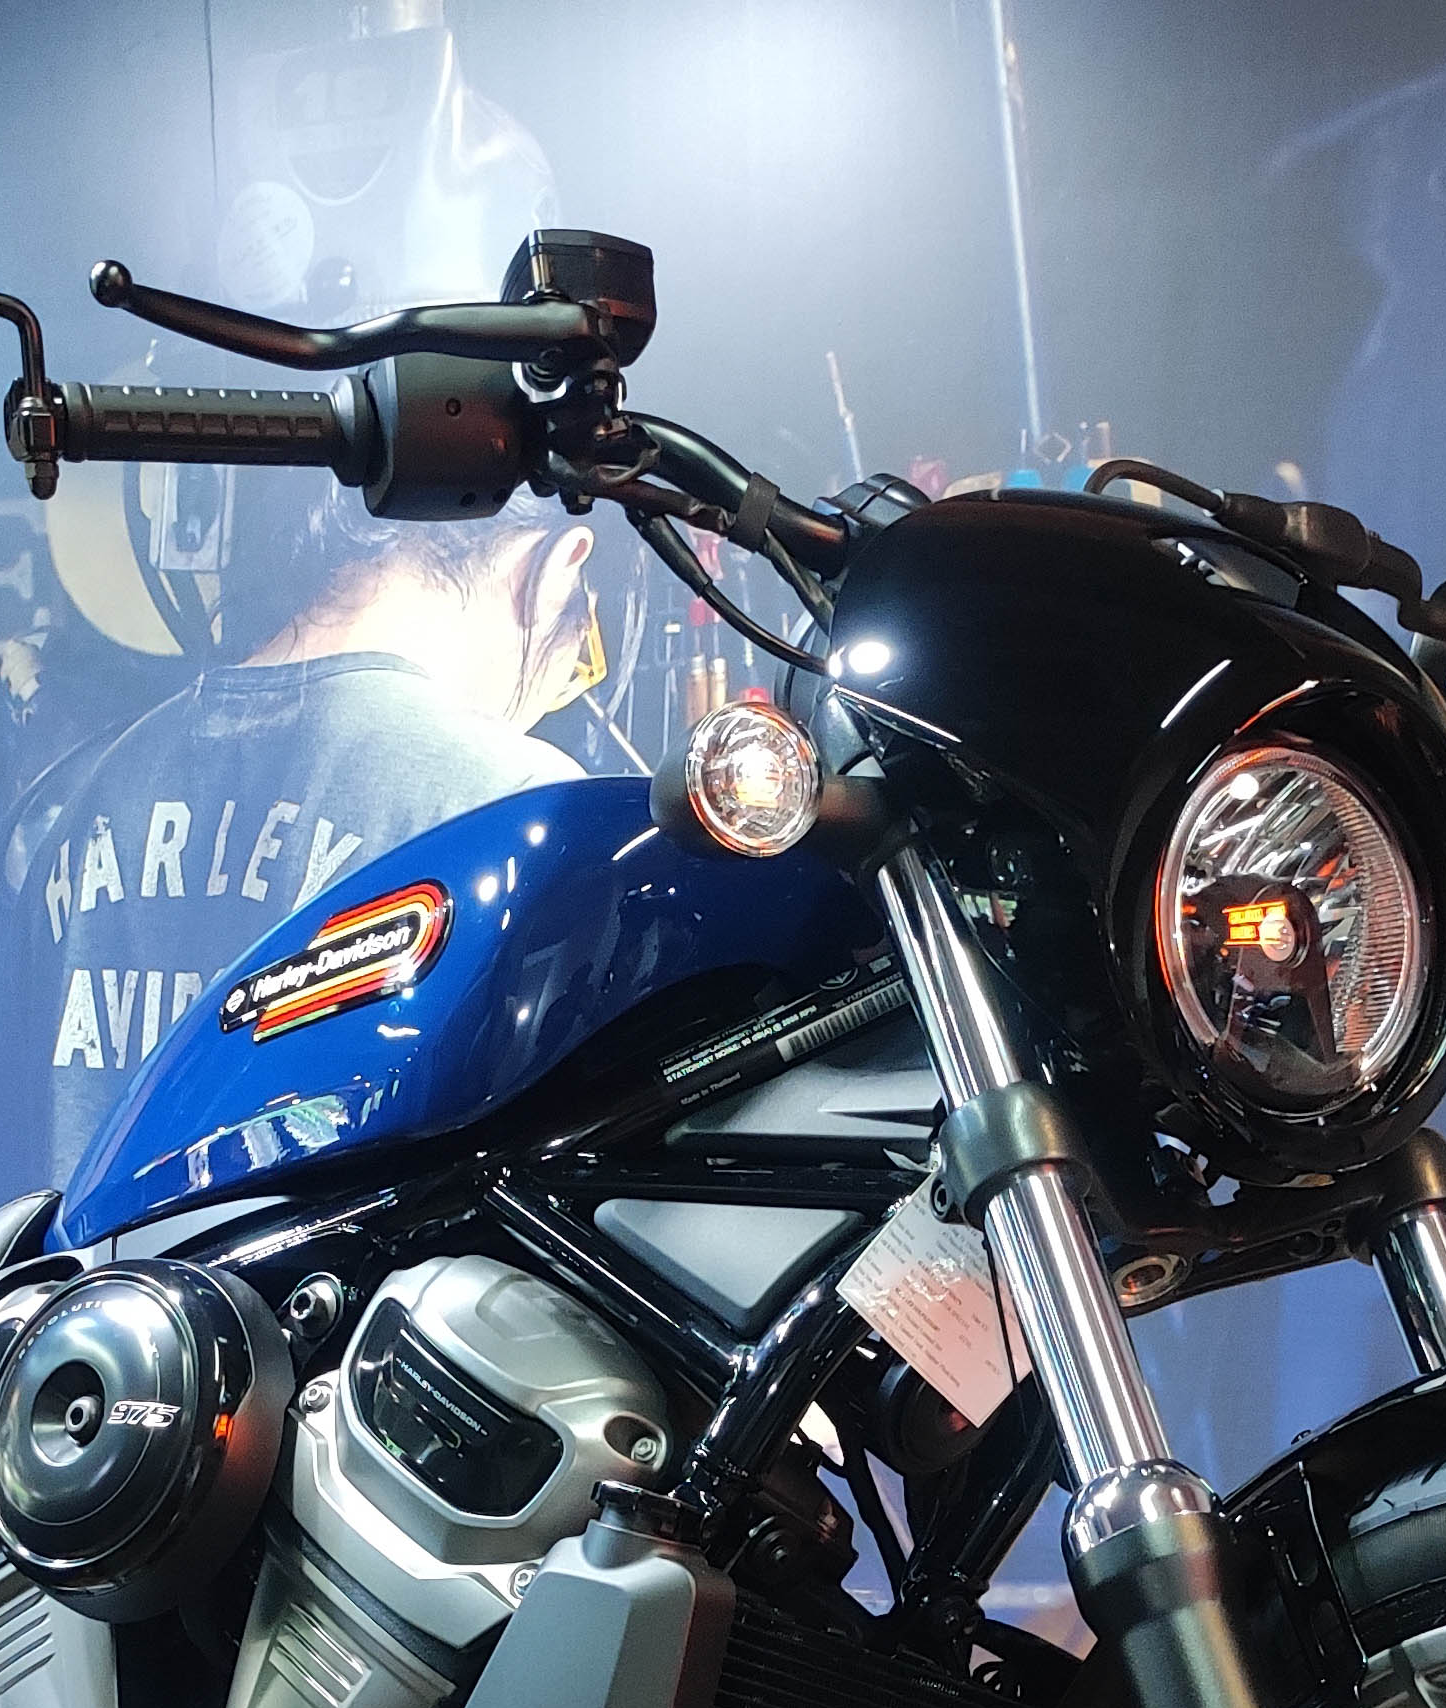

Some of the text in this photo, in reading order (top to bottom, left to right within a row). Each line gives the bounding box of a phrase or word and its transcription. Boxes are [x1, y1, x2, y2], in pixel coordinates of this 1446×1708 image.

[46, 800, 364, 944] HARLEY
[253, 926, 415, 1002] Harley-Davidson
[666, 1054, 714, 1083] STATIONARY
[709, 1071, 741, 1092] Thailand
[18, 1300, 102, 1360] REVOLUTI
[107, 1400, 182, 1427] 975
[400, 1361, 482, 1432] HARLEY-DAVIDSON
